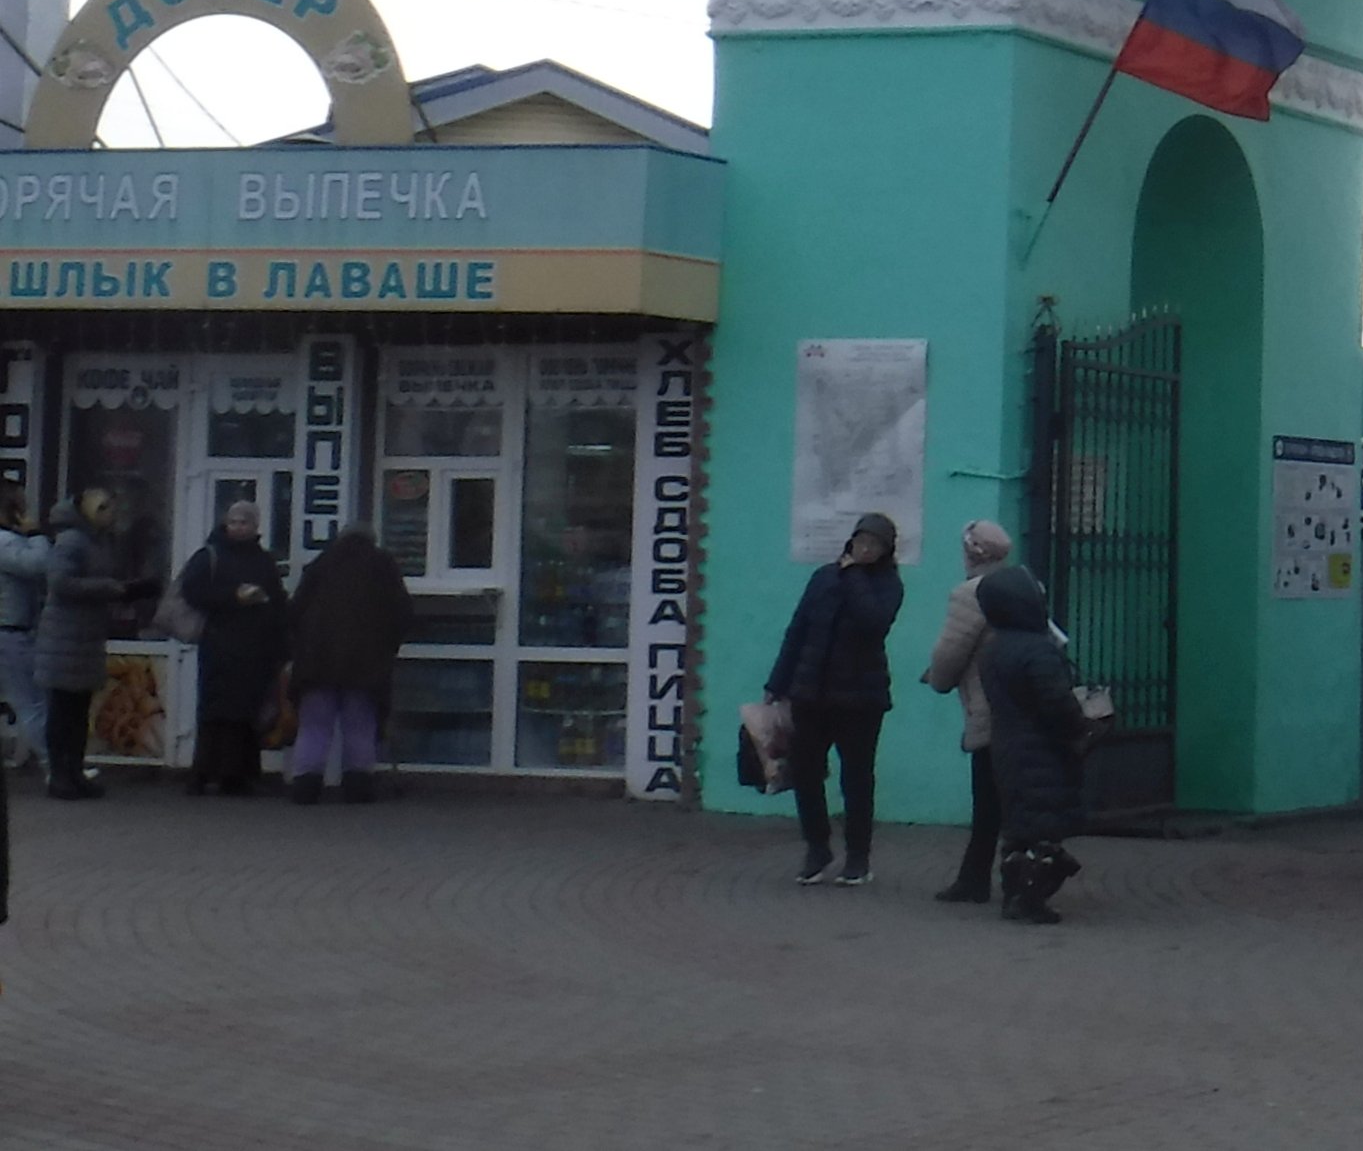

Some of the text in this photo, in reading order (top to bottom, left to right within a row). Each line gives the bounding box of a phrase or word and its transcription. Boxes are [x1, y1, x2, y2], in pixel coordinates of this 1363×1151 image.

[239, 171, 488, 221] ВЫПЕЧКА
[9, 259, 495, 300] ШЛЫК В ЛАВАШЕ
[140, 363, 180, 390] ЧАЙ
[303, 341, 344, 551] ВЫПЕЧ
[645, 338, 692, 792] ХЛЕБ СДОБА ПИЦЦА
